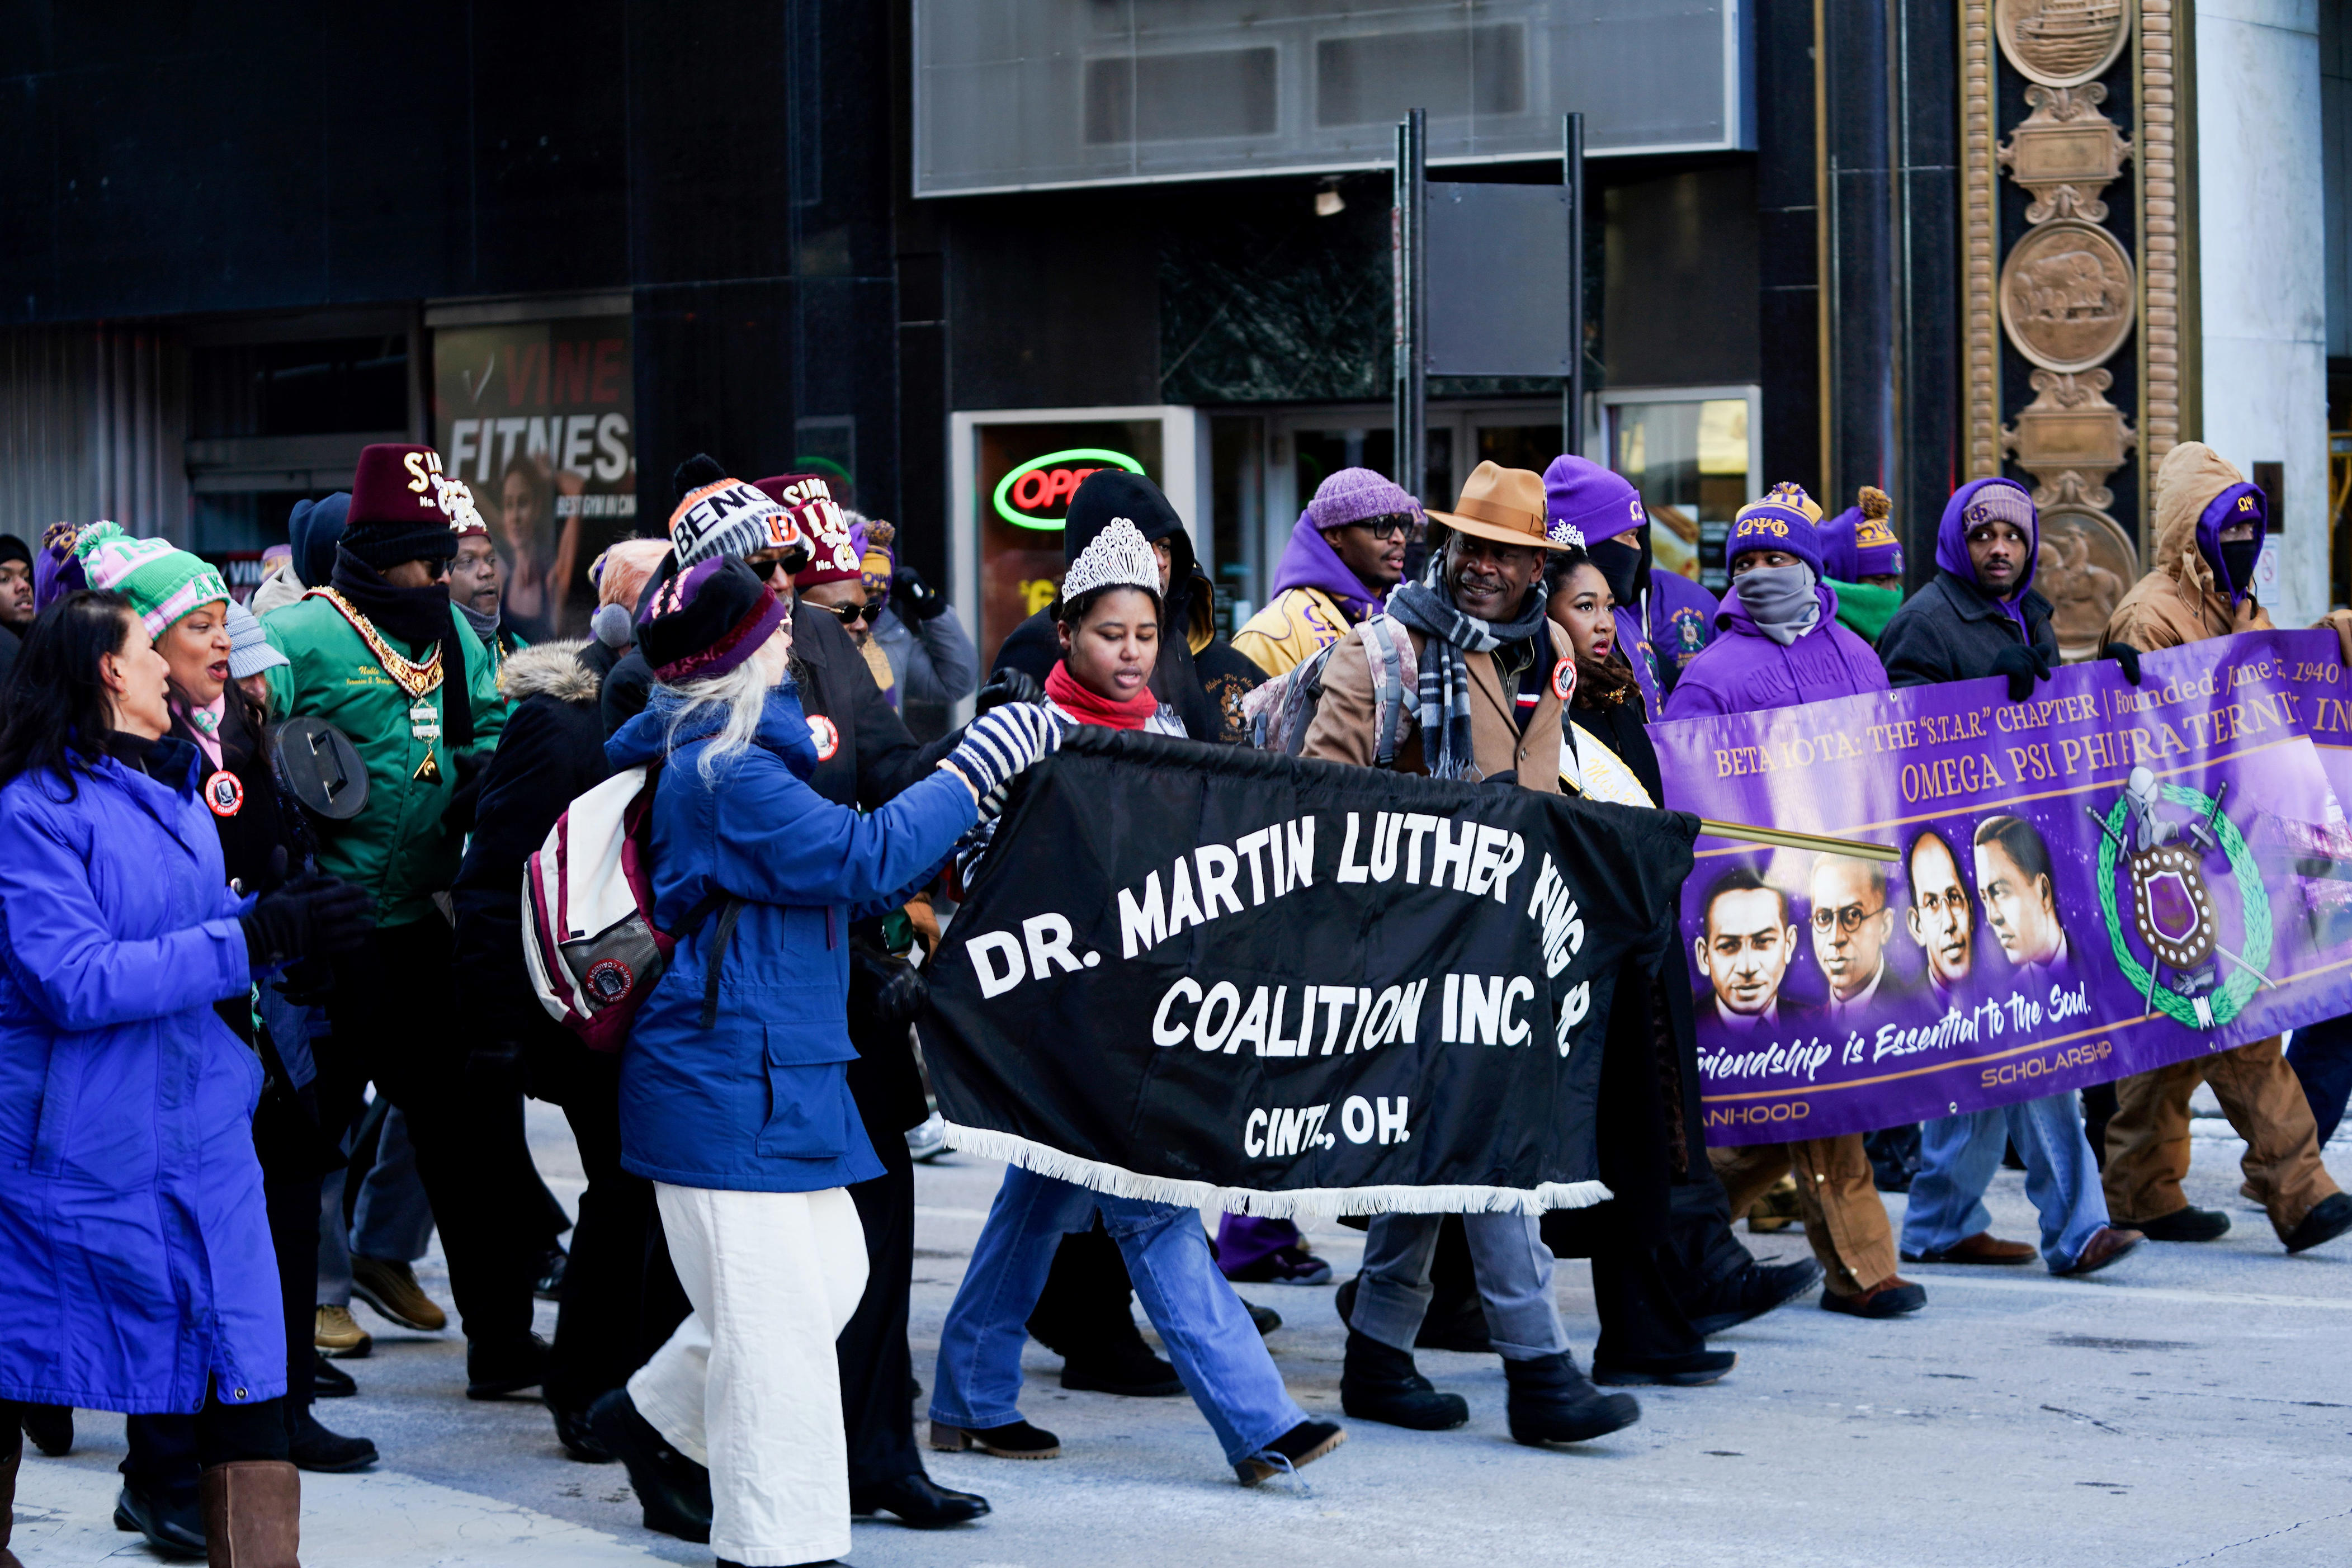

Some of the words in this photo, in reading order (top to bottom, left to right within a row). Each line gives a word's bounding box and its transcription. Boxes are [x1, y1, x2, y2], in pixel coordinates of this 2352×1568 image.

[504, 339, 625, 407] VINE
[448, 412, 636, 484] FITNES
[419, 496, 436, 507] No.
[1013, 468, 1110, 509] OPE
[1736, 517, 1789, 538] ΩΨΦ
[816, 560, 835, 572] No.
[358, 665, 380, 674] Noble
[1714, 745, 1778, 777] BETA
[1779, 731, 1864, 768] IOTA:
[1866, 720, 1919, 752] THE
[1996, 693, 2100, 732] CHAPTER
[2114, 668, 2220, 714] Founded:
[2226, 662, 2272, 696] June
[2292, 662, 2340, 684] 1940
[1901, 753, 2006, 803] OMEGA
[2006, 743, 2058, 783] PSI
[2058, 733, 2118, 775] PHI
[2118, 691, 2302, 764] FRATERNI
[2312, 697, 2352, 734] IN
[965, 912, 1101, 999] DR.
[1117, 815, 1315, 960] MARTIN
[1337, 811, 1524, 903] LUTHER
[1528, 852, 1585, 979] KING
[1151, 976, 1428, 1057] COALITION
[1842, 1030, 1865, 1065] is
[1873, 1005, 1981, 1064] Essential
[2047, 980, 2091, 1023] Soul.
[1981, 1040, 2113, 1089] SCHOLARSHIP
[1342, 1094, 1410, 1145] OH.
